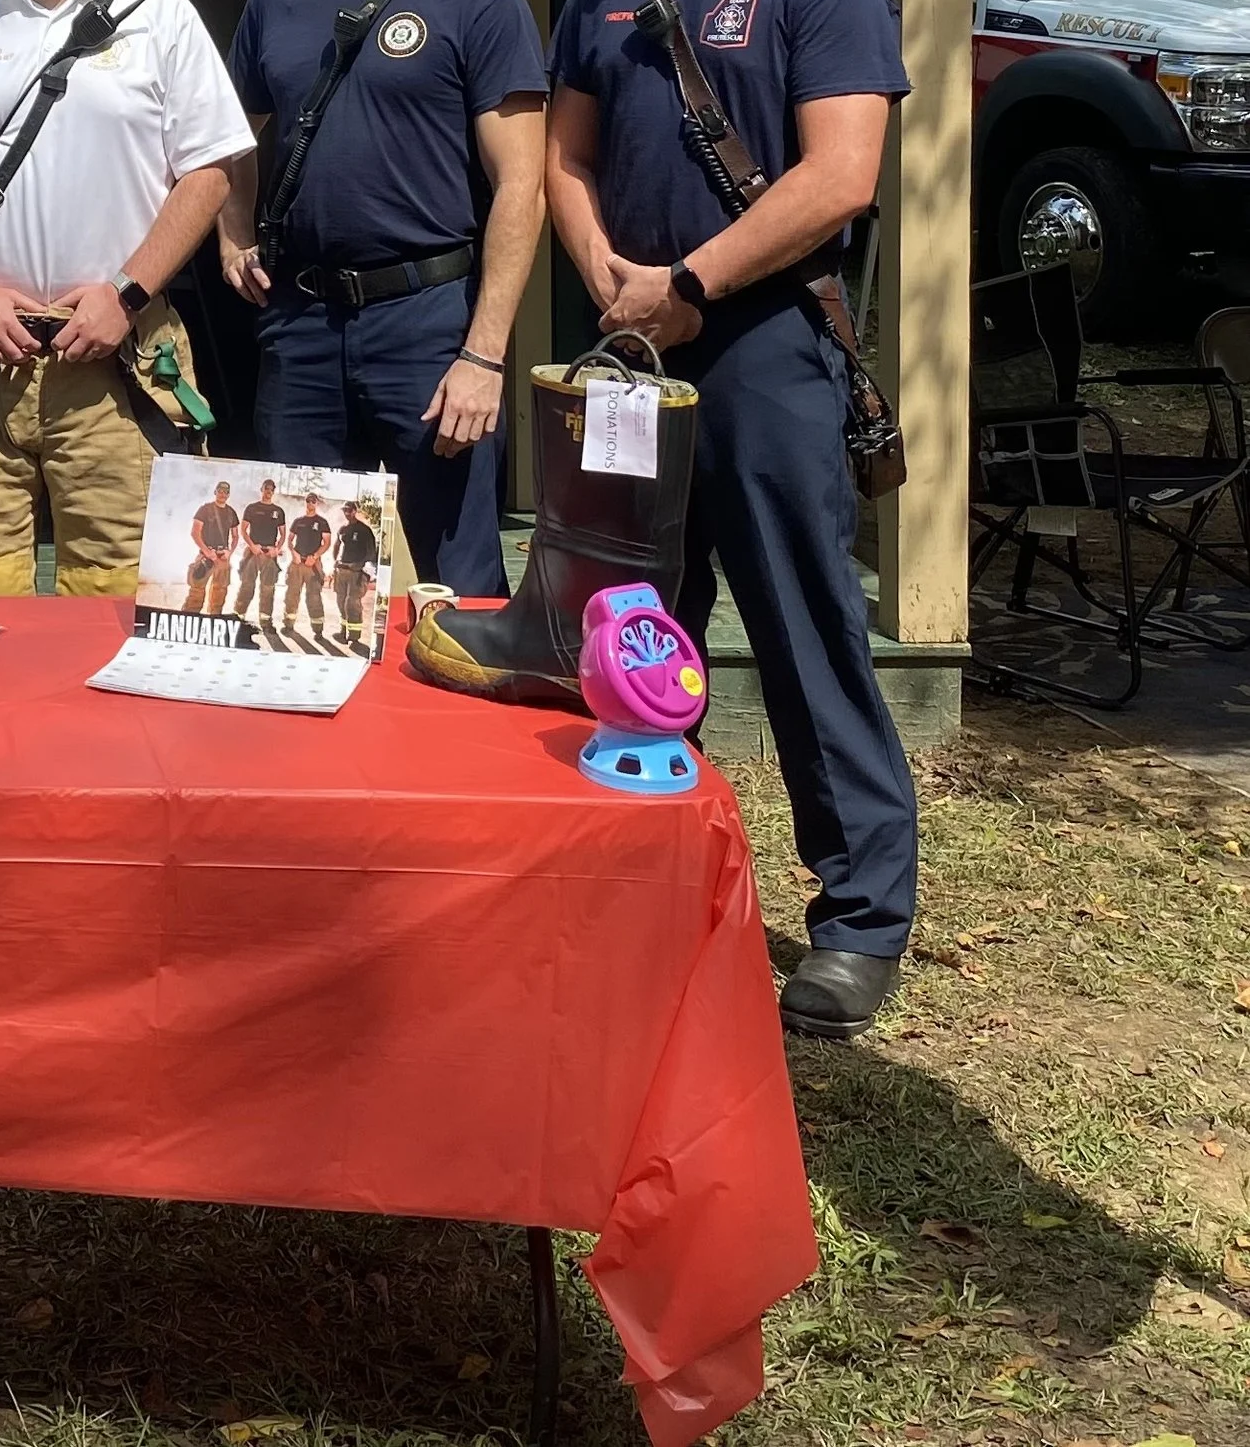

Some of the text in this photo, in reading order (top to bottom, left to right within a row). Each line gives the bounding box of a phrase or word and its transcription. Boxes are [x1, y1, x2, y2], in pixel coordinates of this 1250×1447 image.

[1054, 12, 1148, 41] RESCUE
[604, 390, 619, 469] DONATIONS
[147, 612, 241, 648] JANUARY
